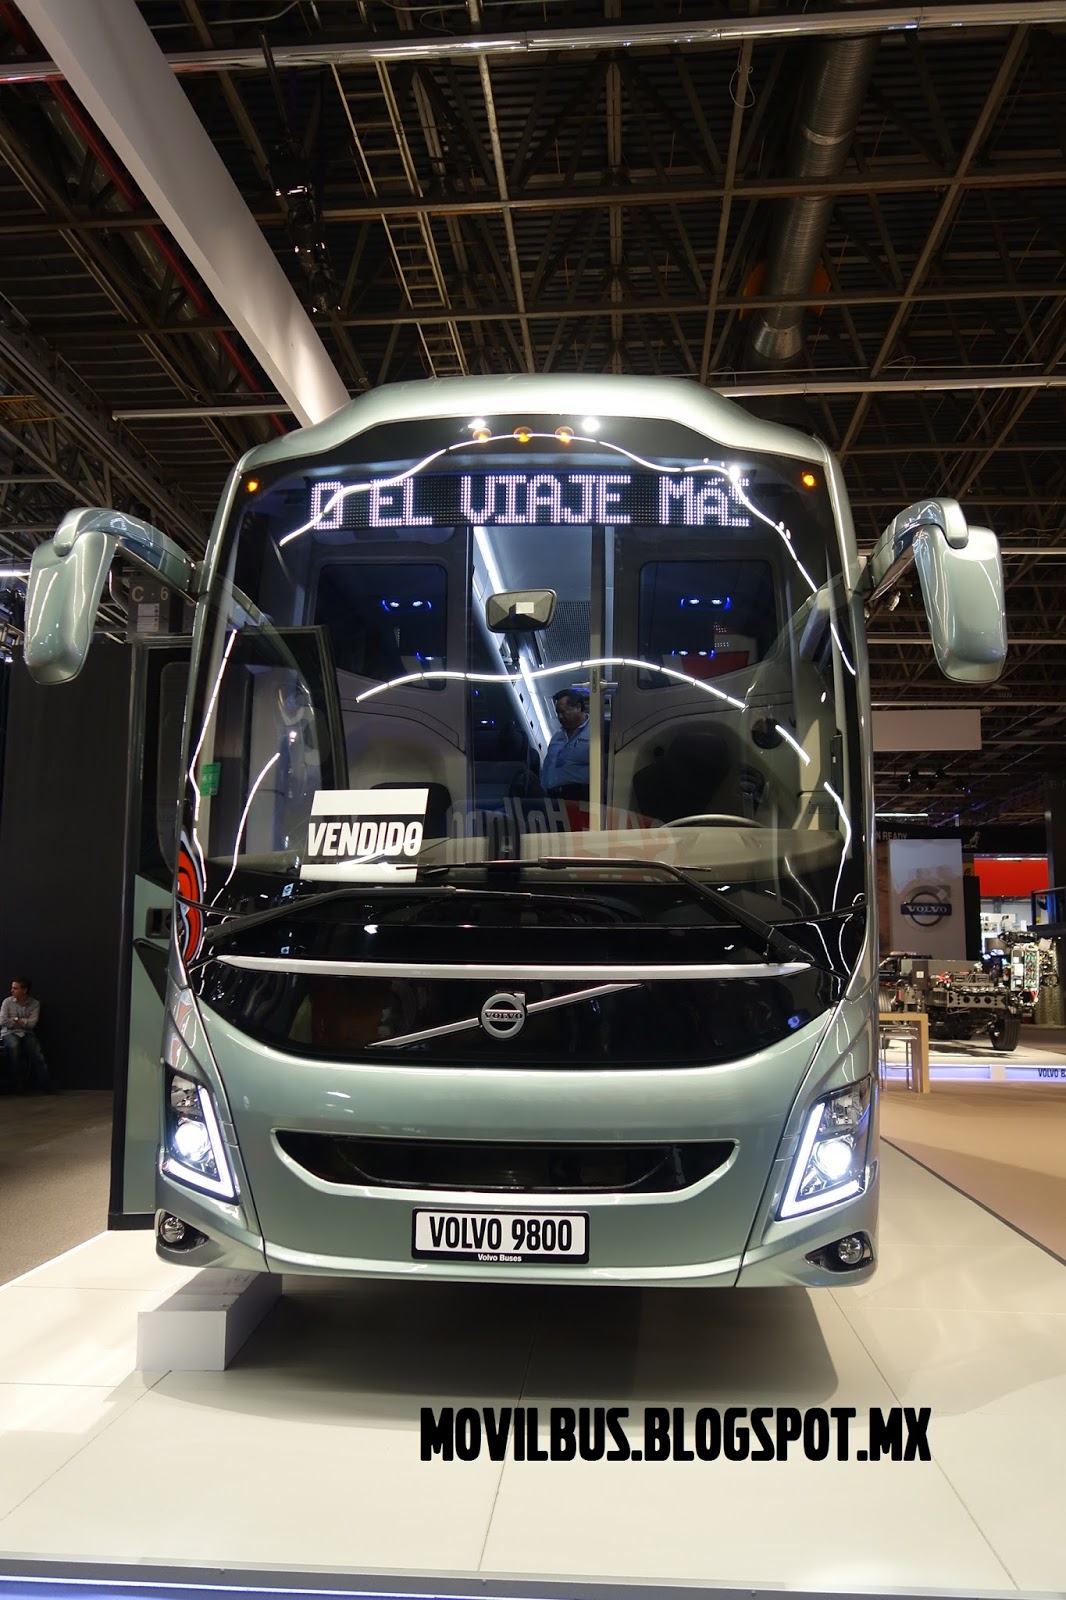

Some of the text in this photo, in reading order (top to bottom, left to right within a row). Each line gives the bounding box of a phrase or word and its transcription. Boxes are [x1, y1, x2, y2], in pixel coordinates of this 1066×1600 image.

[369, 477, 433, 528] EL
[461, 475, 631, 524] VIAJE
[307, 821, 424, 857] VENDIDO
[1038, 1068, 1058, 1077] VOLVO
[429, 1216, 573, 1251] VOLVO 9800
[478, 1253, 522, 1262] Volvo Buses
